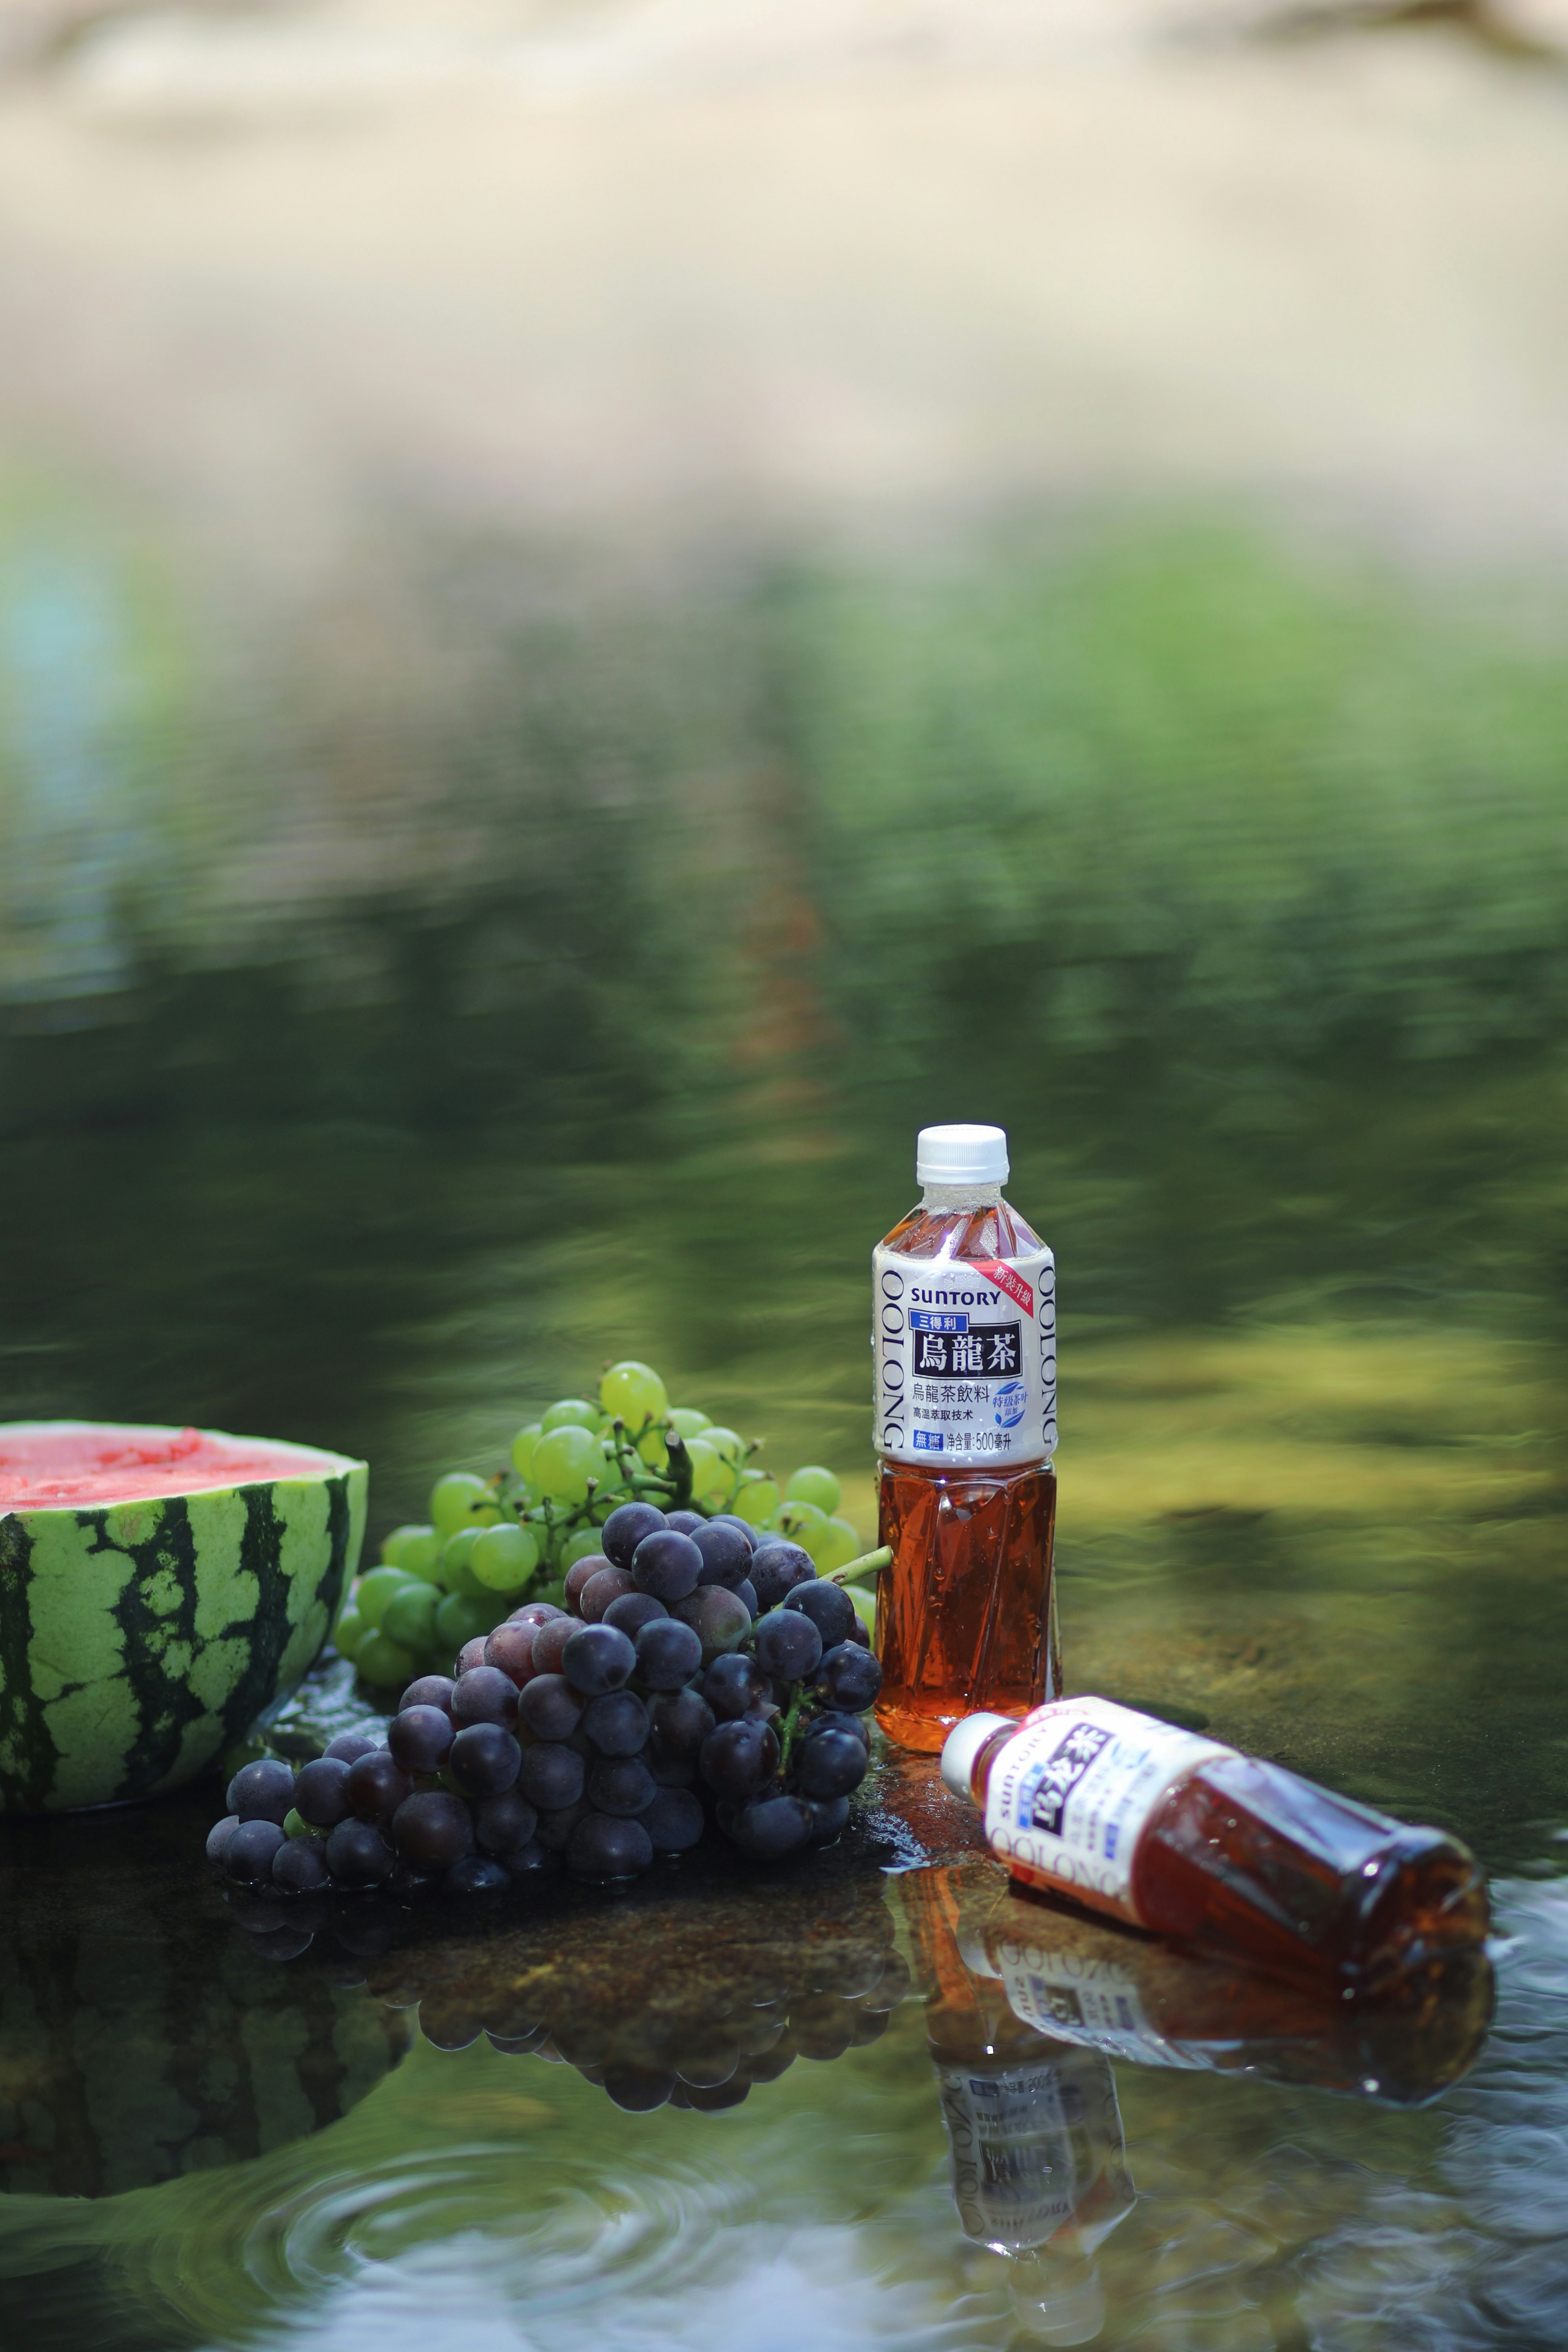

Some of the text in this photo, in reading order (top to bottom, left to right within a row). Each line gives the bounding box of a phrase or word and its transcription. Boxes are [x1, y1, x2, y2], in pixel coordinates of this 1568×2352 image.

[993, 1265, 1032, 1307] 新裝升級
[919, 1315, 957, 1330] 三得利
[881, 1270, 904, 1451] OOLONG
[919, 1333, 1016, 1372] 烏龍茶
[1038, 1266, 1057, 1446] OOLONG
[912, 1382, 990, 1403] 烏龍茶飲料
[992, 1391, 1028, 1408] 特级茶叶
[913, 1407, 973, 1421] 高温萃取技术
[1004, 1407, 1018, 1416] 添加
[915, 1431, 940, 1450] 無糖
